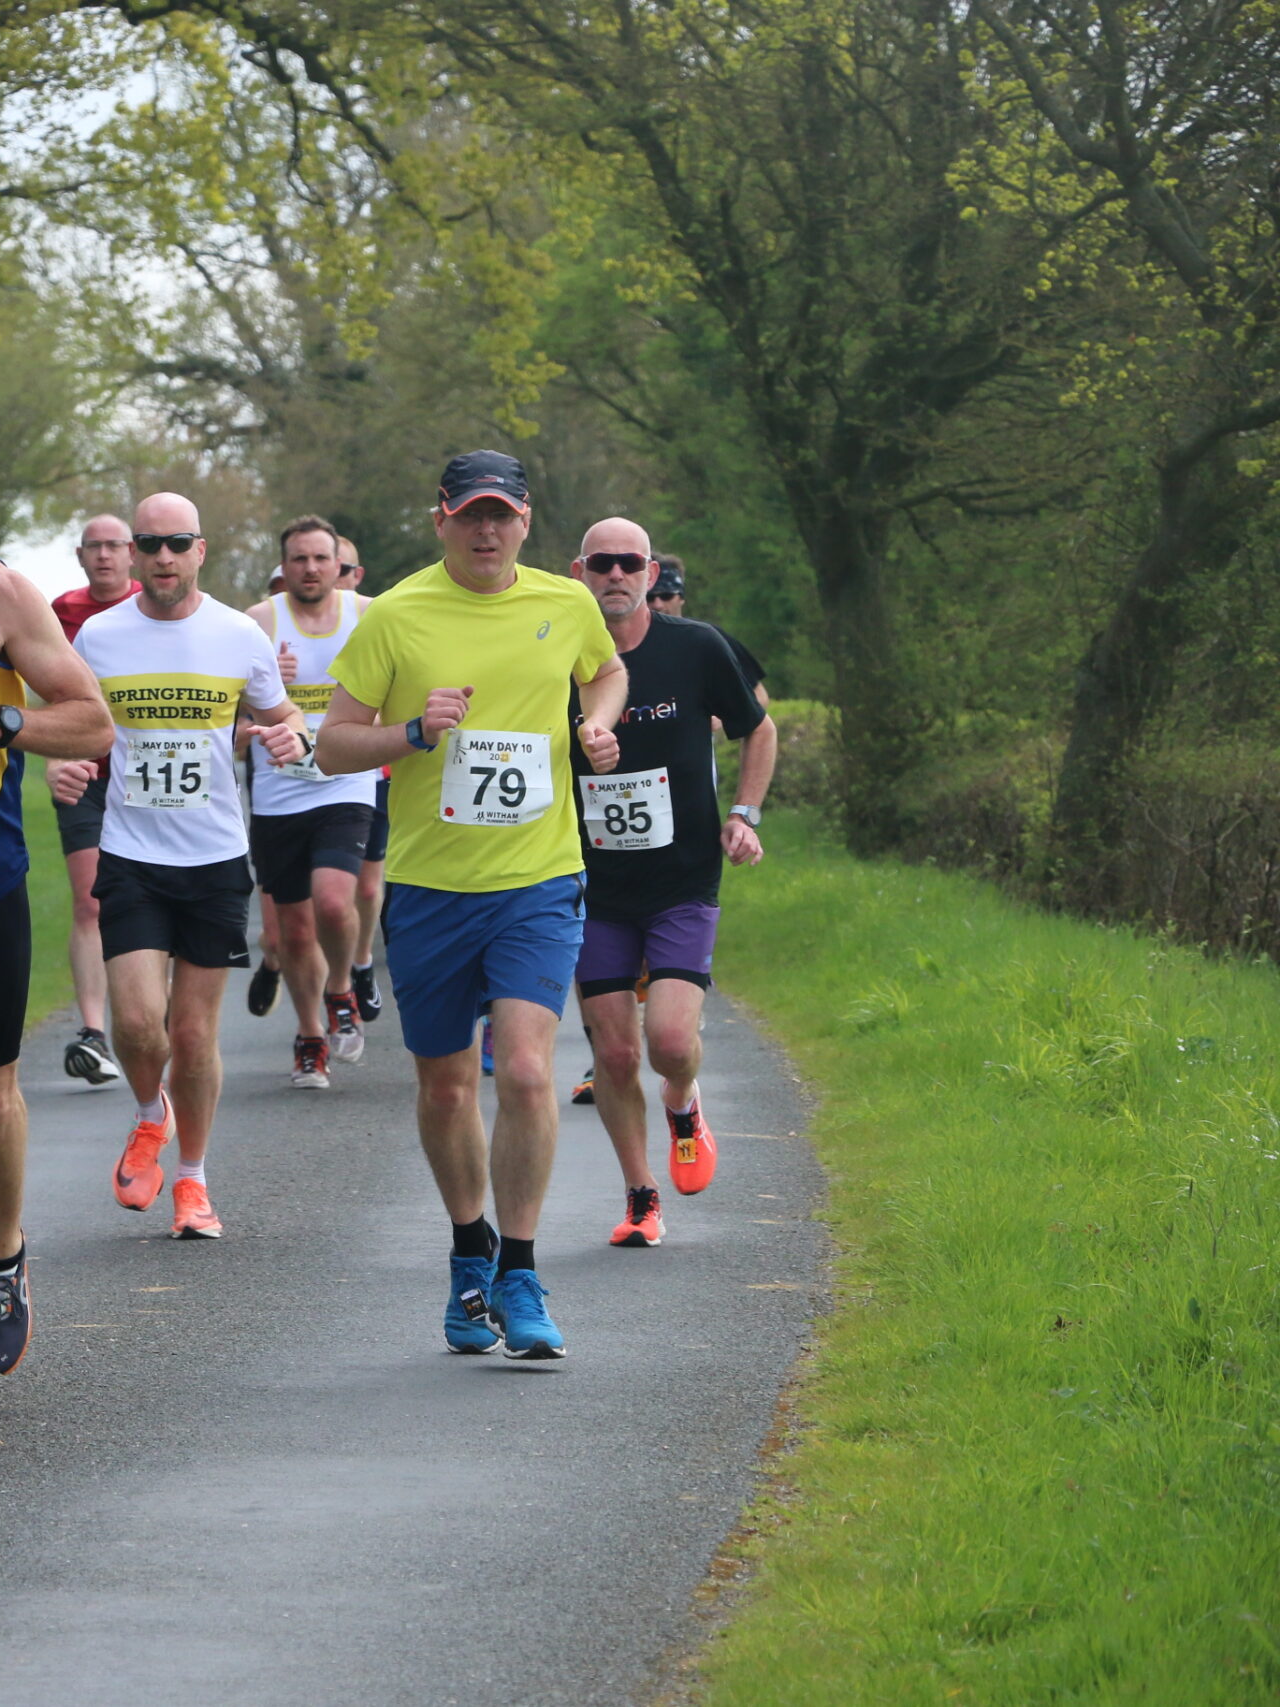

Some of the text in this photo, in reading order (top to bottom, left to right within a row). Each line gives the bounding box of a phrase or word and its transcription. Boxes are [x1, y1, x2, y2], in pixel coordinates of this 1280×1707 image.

[110, 688, 228, 703] SPRINGFIELD
[127, 706, 212, 720] STRIDERS
[142, 741, 196, 750] MAY DAY 10
[470, 740, 533, 754] MAY DAY 10
[136, 761, 202, 794] 115
[470, 766, 527, 808] 79
[598, 779, 652, 793] MAY DAY 10
[486, 811, 519, 819] WITHAM
[603, 801, 652, 836] 85
